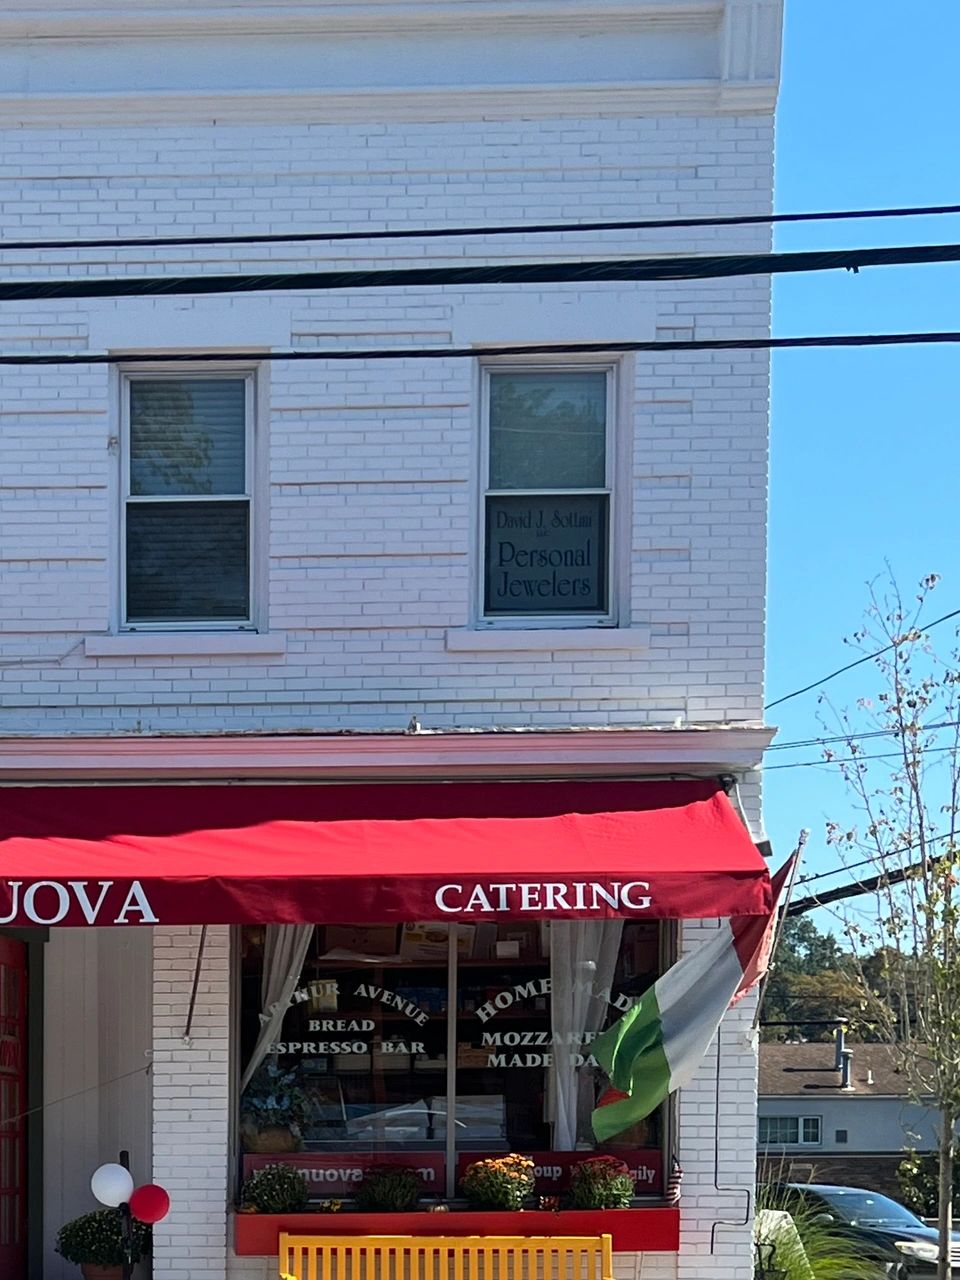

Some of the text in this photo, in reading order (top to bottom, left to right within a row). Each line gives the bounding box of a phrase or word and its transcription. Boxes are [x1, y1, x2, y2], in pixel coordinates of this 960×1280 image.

[496, 509, 531, 528] David
[498, 538, 592, 567] Personal
[497, 570, 592, 597] Jewelers
[434, 880, 652, 912] CATERING
[354, 983, 430, 1027] AVENUE
[308, 1020, 375, 1032] BREAD
[266, 1041, 426, 1054] ESPRESSO BAR
[487, 1053, 554, 1067] MADE
